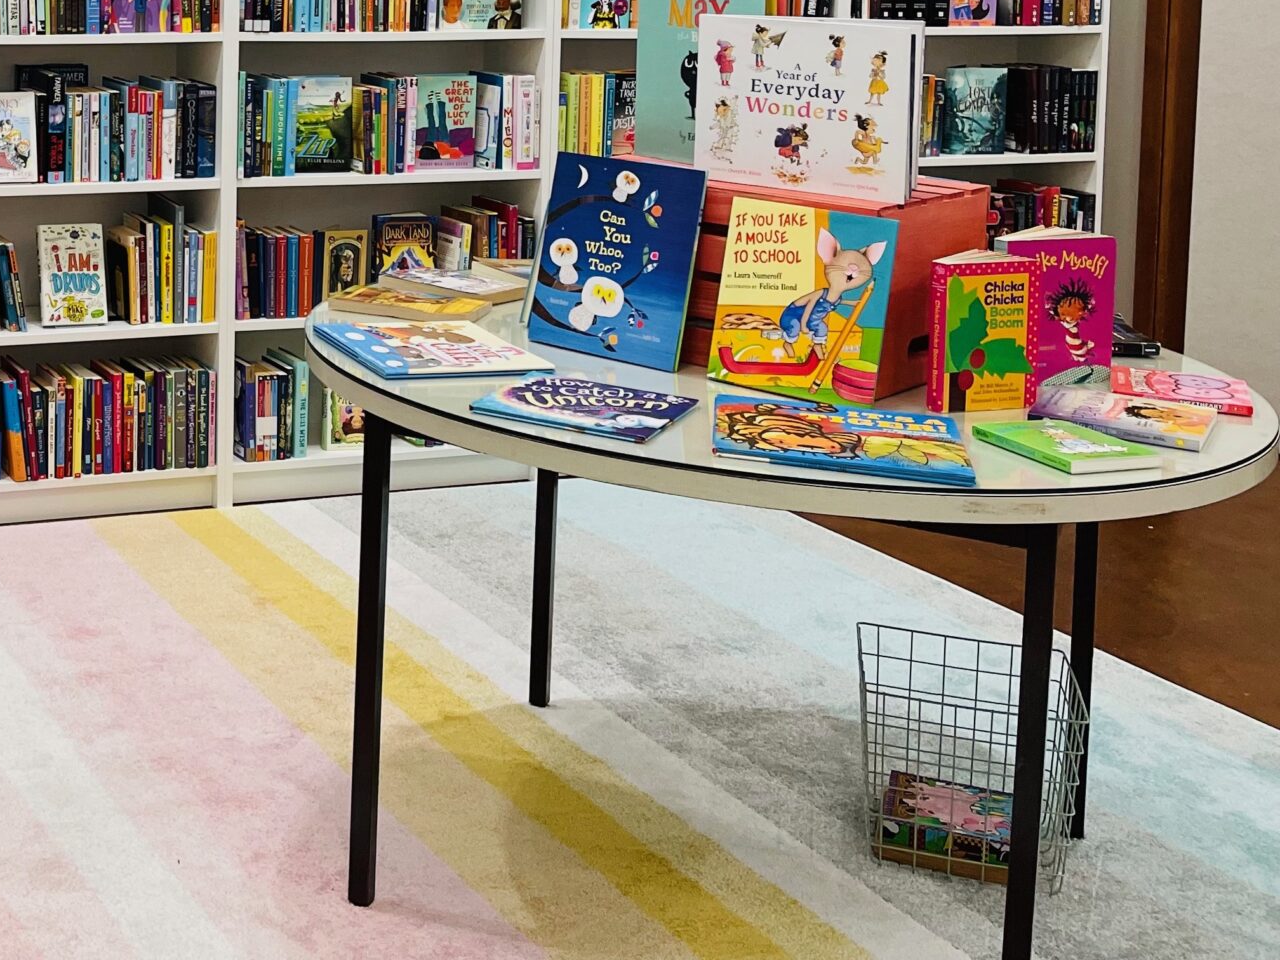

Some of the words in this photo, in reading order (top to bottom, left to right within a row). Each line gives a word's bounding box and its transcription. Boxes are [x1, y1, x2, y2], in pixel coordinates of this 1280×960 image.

[794, 63, 802, 71] A
[776, 70, 801, 81] Year
[804, 72, 817, 82] of
[451, 80, 469, 88] THE
[750, 78, 845, 104] Everyday
[444, 88, 473, 96] GREAT
[447, 111, 470, 119] LUCY
[745, 96, 848, 122] Wonders
[453, 118, 465, 126] WU
[276, 142, 284, 161] TIME
[599, 209, 626, 226] Can
[735, 213, 748, 228] IF
[751, 213, 774, 228] YOU
[778, 212, 808, 228] TAKE
[385, 225, 407, 240] DARK
[408, 225, 431, 240] LAND
[603, 226, 631, 244] You
[735, 231, 742, 244] A
[746, 230, 789, 245] MOUSE
[585, 241, 624, 261] Whoo,
[734, 249, 748, 264] TO
[752, 249, 802, 264] SCHOOL
[67, 252, 91, 272] AM
[588, 258, 622, 275] Too?
[1059, 249, 1109, 279] Myself!
[733, 271, 750, 279] Laura
[752, 271, 782, 279] Numeroff
[51, 272, 101, 296] DRUMS
[759, 282, 779, 290] Felicia
[780, 283, 797, 291] Bond
[984, 281, 1025, 294] Chicka
[984, 293, 1024, 306] Chicka
[990, 307, 1024, 317] Boom
[990, 319, 1024, 329] Boom
[545, 376, 595, 388] How
[531, 382, 553, 393] to
[557, 385, 634, 399] Catch
[644, 392, 657, 401] a
[520, 390, 670, 412] Unicorn
[798, 412, 948, 434] TIGER!
[846, 410, 915, 423] IT'S
[922, 418, 947, 426] A
